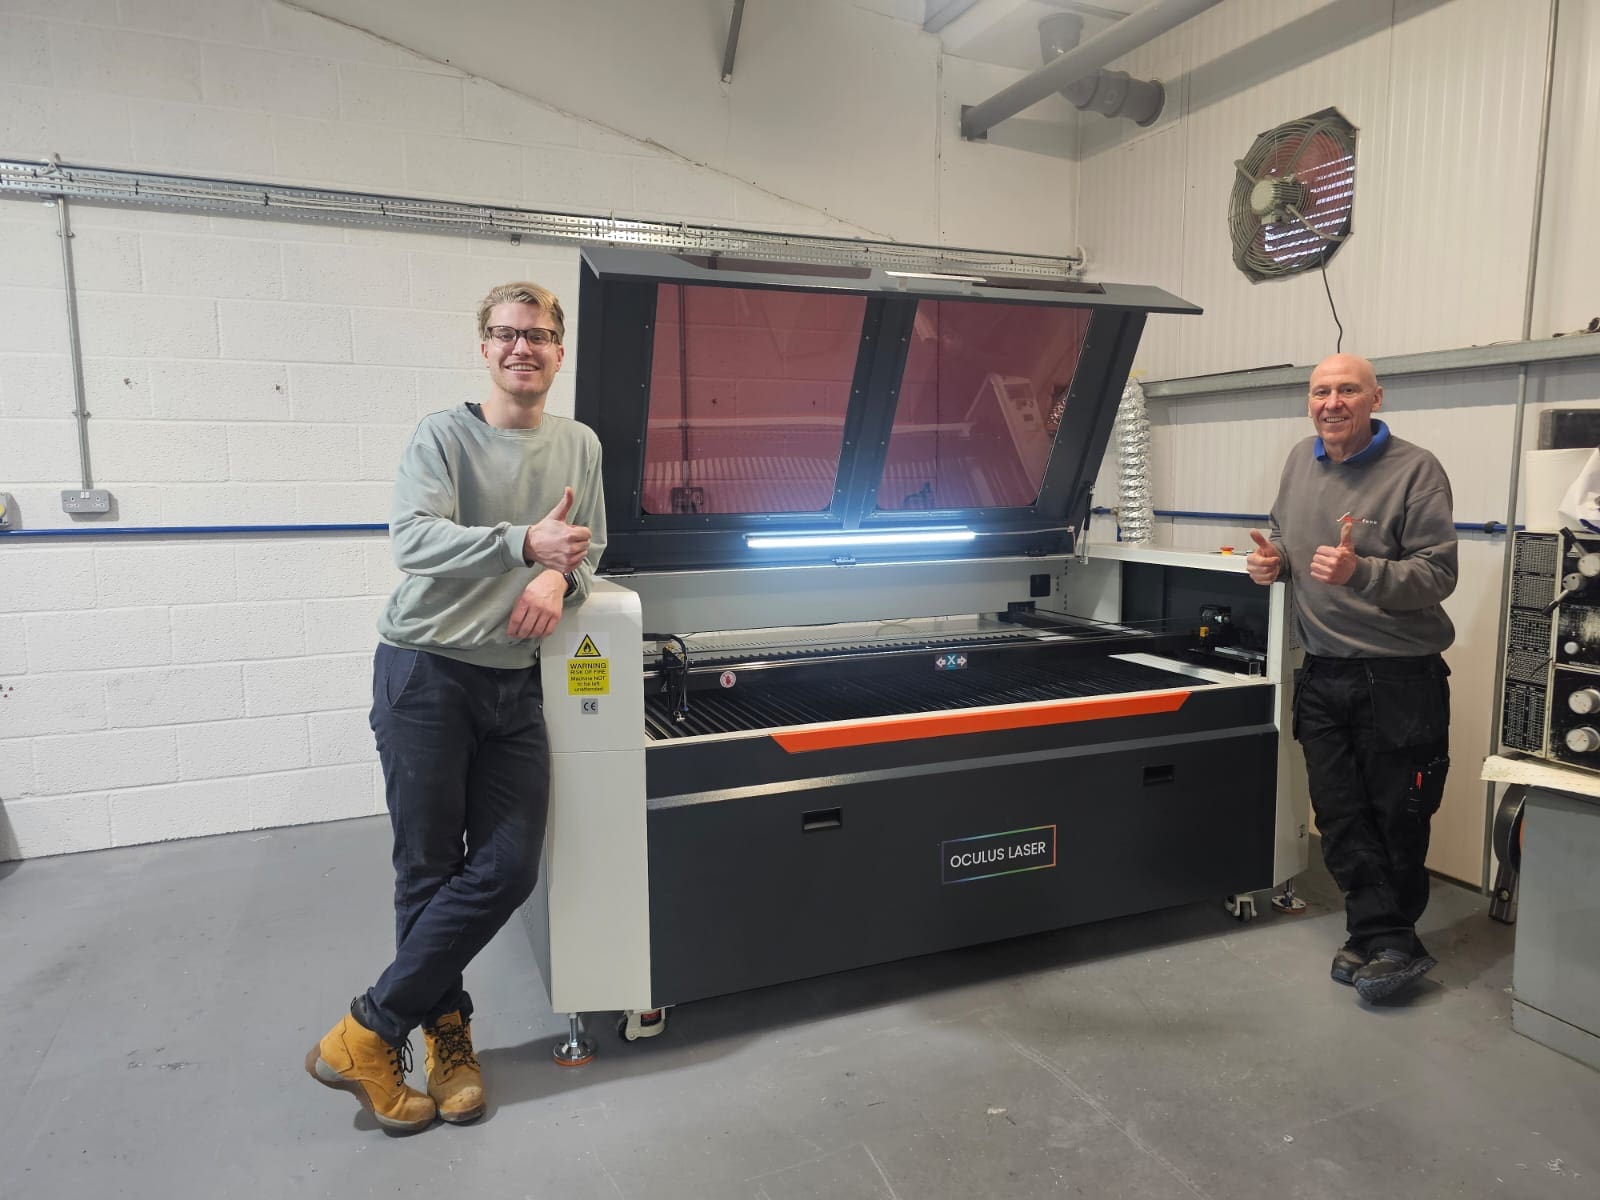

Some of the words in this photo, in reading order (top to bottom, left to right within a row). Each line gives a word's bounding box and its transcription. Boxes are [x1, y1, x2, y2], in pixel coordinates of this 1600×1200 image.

[947, 655, 956, 665] X
[583, 702, 596, 711] CE
[950, 848, 1005, 868] OCULUS
[1008, 841, 1046, 859] LASER
